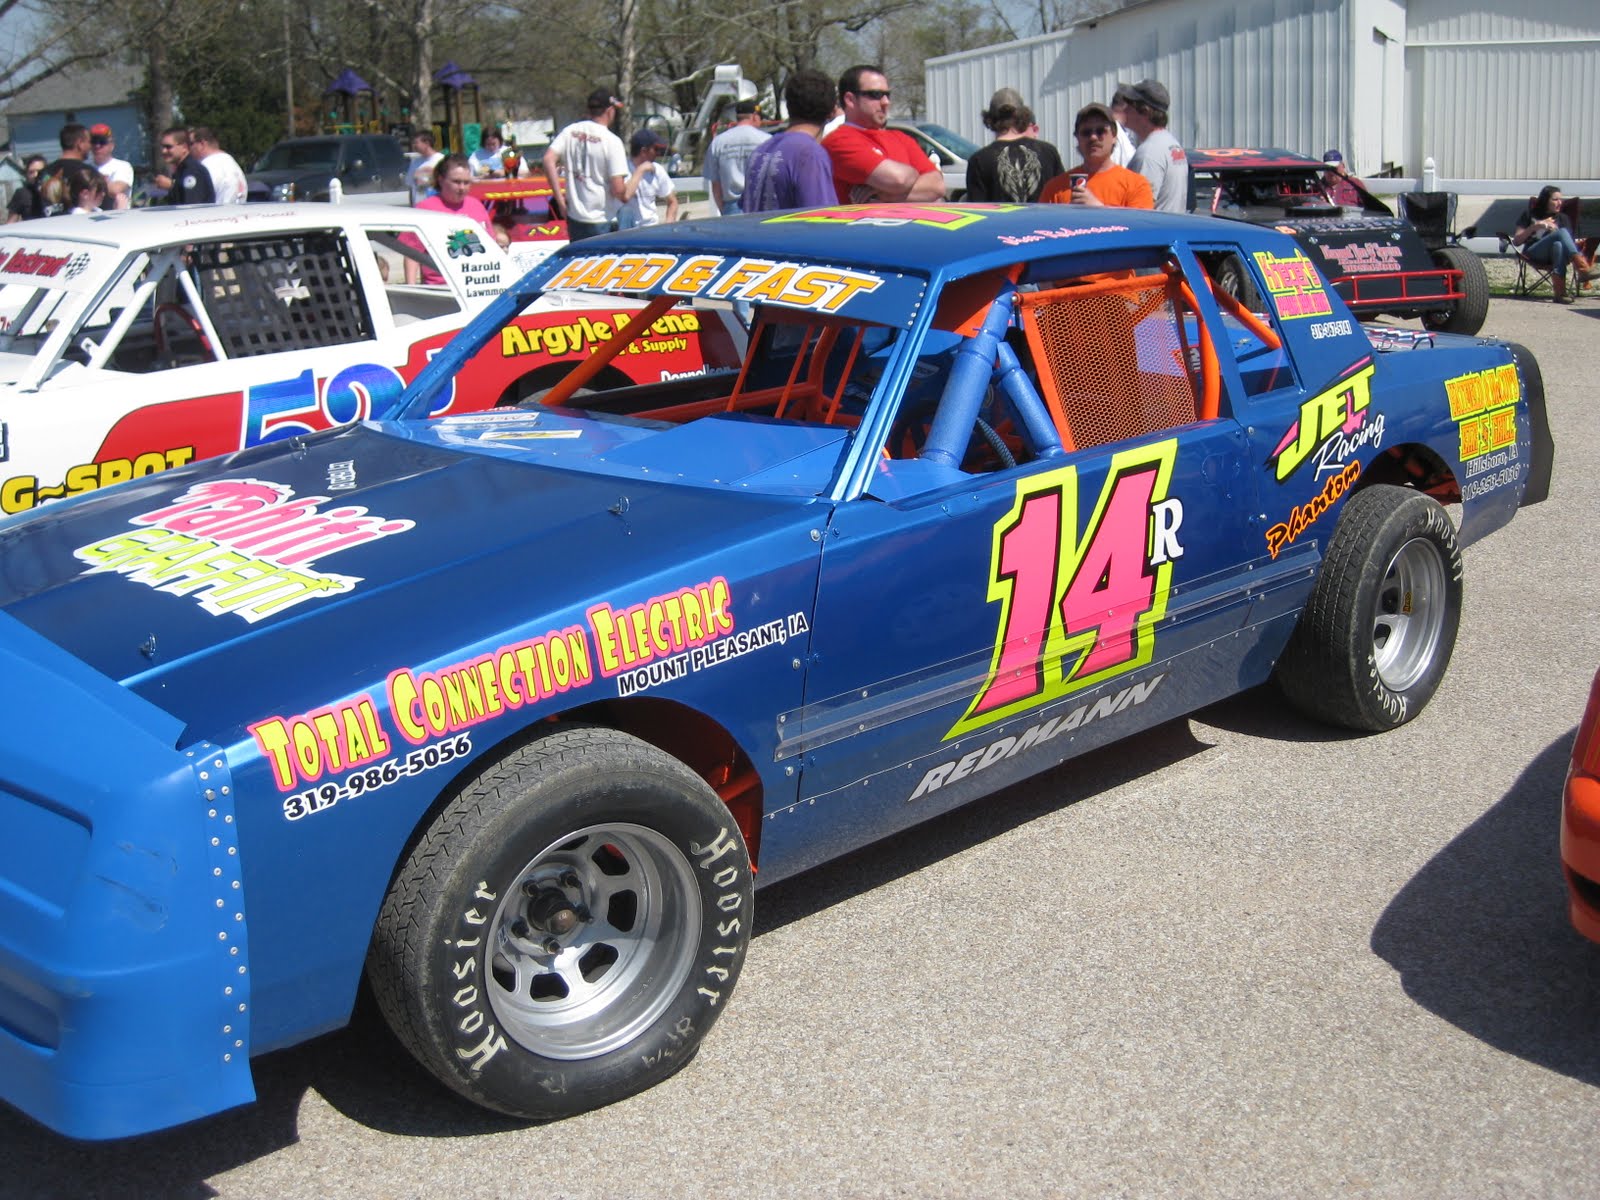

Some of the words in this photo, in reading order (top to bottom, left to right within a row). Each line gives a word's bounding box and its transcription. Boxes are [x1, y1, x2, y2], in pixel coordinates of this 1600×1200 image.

[461, 261, 501, 273] Harold
[465, 274, 501, 286] Pundt
[542, 255, 675, 293] HARD
[662, 256, 724, 297] &
[707, 258, 884, 313] FAST
[502, 317, 614, 357] Argyle
[611, 312, 702, 337] Aena
[643, 337, 688, 355] Supply
[1276, 364, 1375, 480] JET
[1312, 413, 1386, 482] Racing
[1265, 459, 1362, 560] Phantom
[943, 439, 1178, 740] 14
[1150, 497, 1184, 565] R
[247, 695, 391, 792] TOTAL
[386, 623, 592, 745] CONNECTION
[586, 576, 735, 678] ELECTRIC
[617, 652, 693, 697] MOUNT
[690, 620, 790, 669] PLEASANT,
[787, 612, 809, 637] IA
[283, 731, 472, 821] 319-986-5056
[908, 674, 1165, 802] REDMANN
